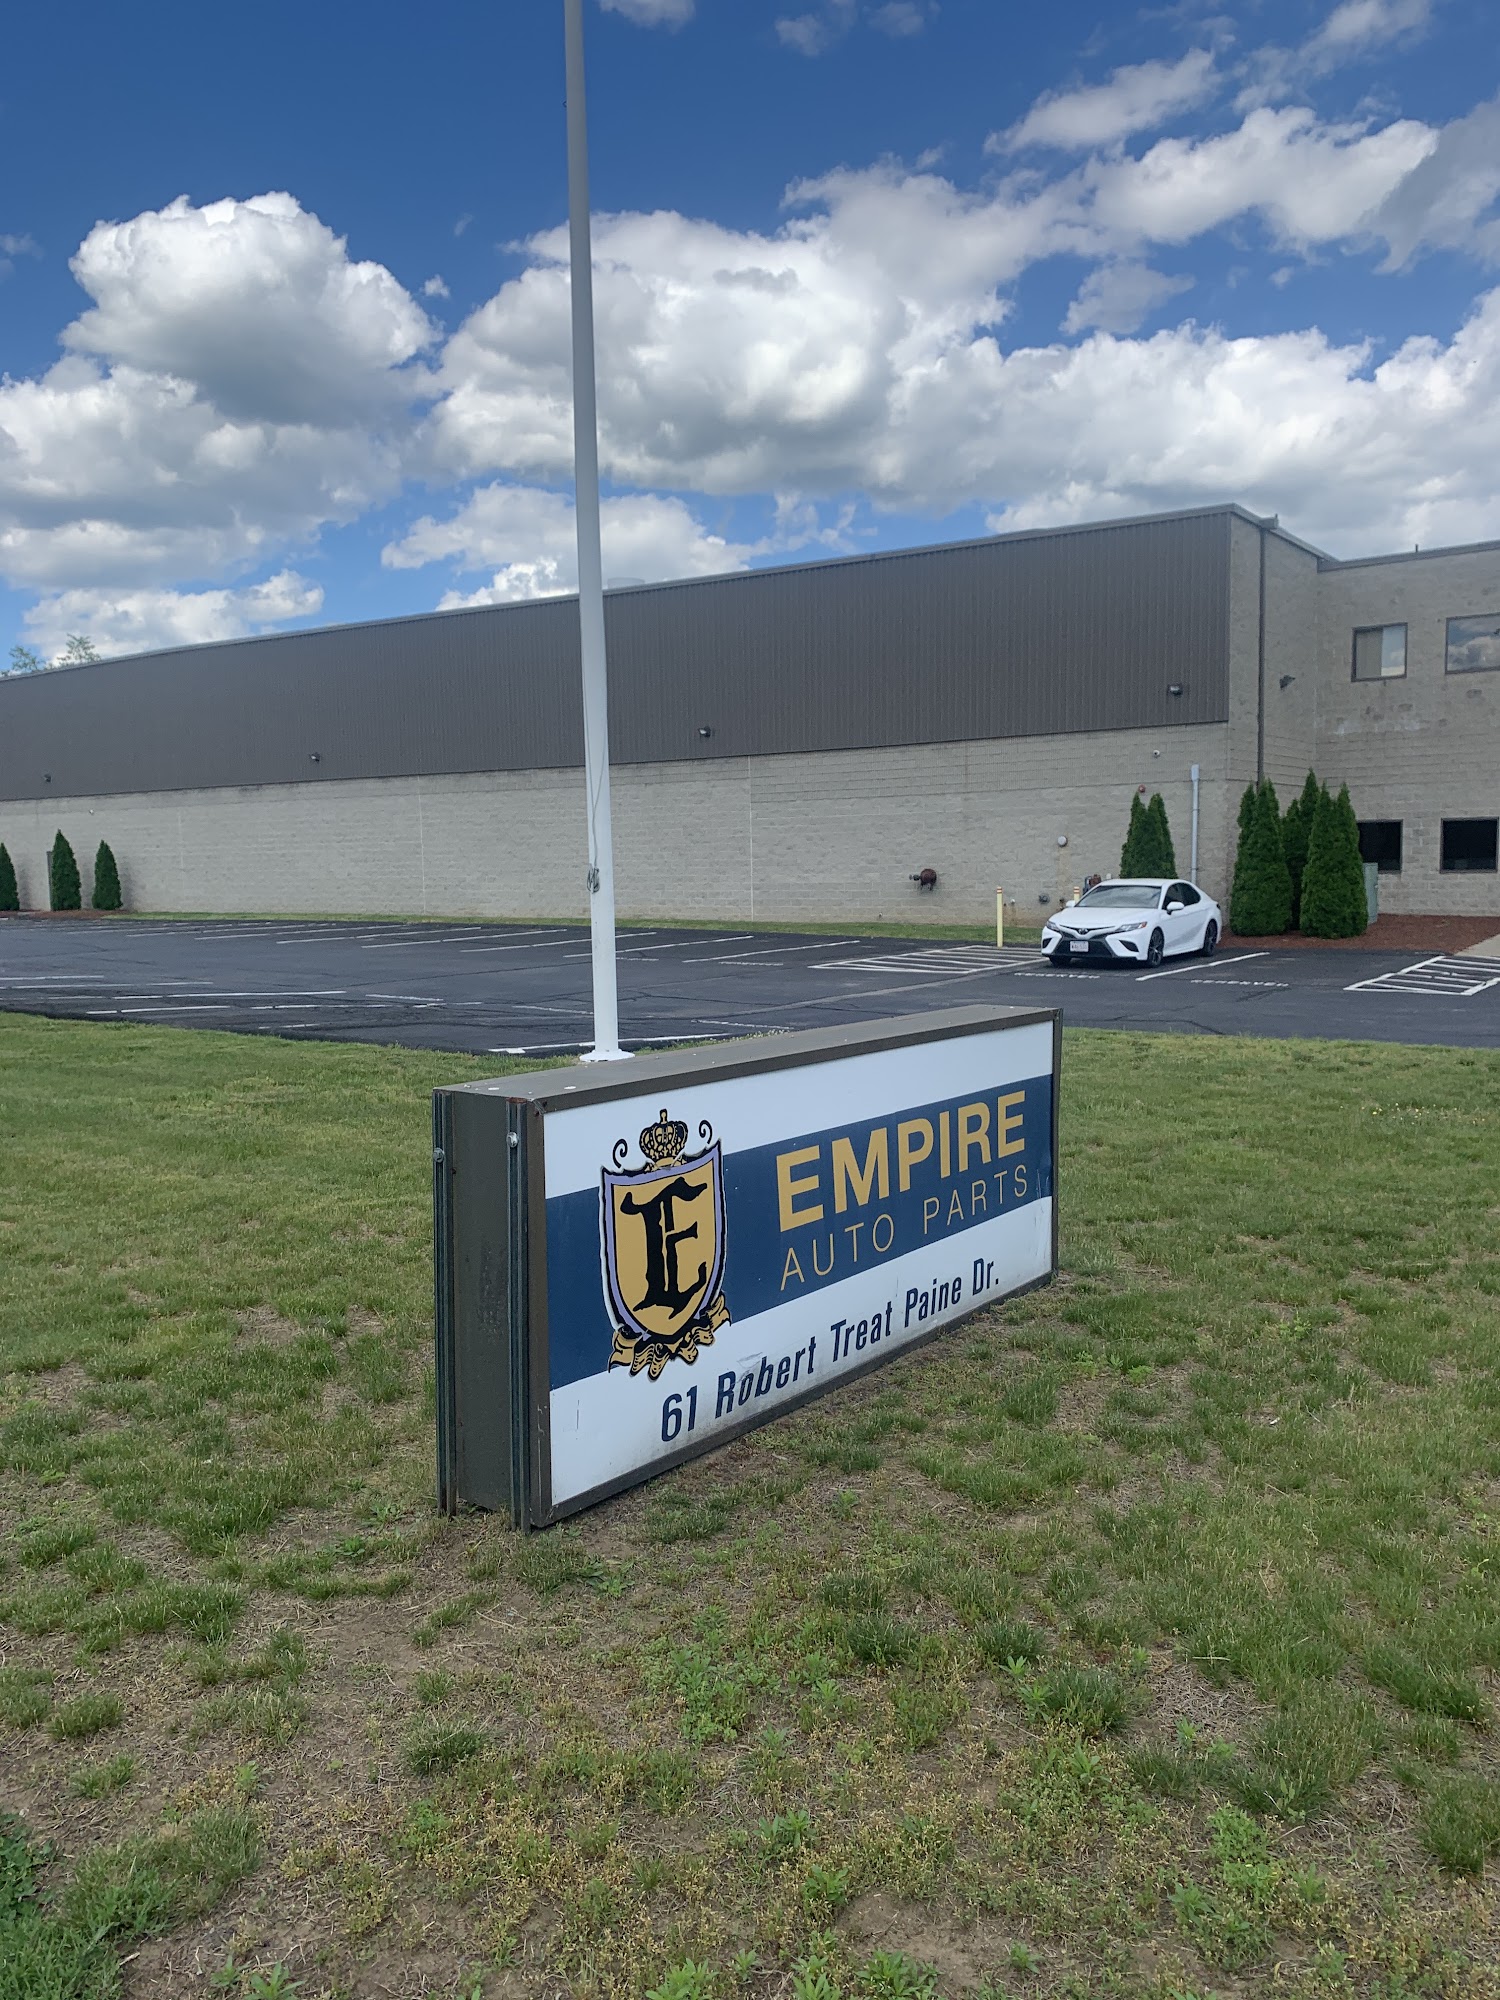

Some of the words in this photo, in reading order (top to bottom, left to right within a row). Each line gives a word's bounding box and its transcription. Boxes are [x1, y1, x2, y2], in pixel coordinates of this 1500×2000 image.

[776, 1090, 1026, 1232] EMPIRE
[781, 1213, 895, 1291] AUTO
[923, 1164, 1027, 1234] PARTS
[662, 1384, 698, 1443] 61
[715, 1335, 817, 1419] Robert
[831, 1300, 893, 1363] Treat
[904, 1276, 962, 1329] Paine
[973, 1258, 1000, 1296] Dr.
